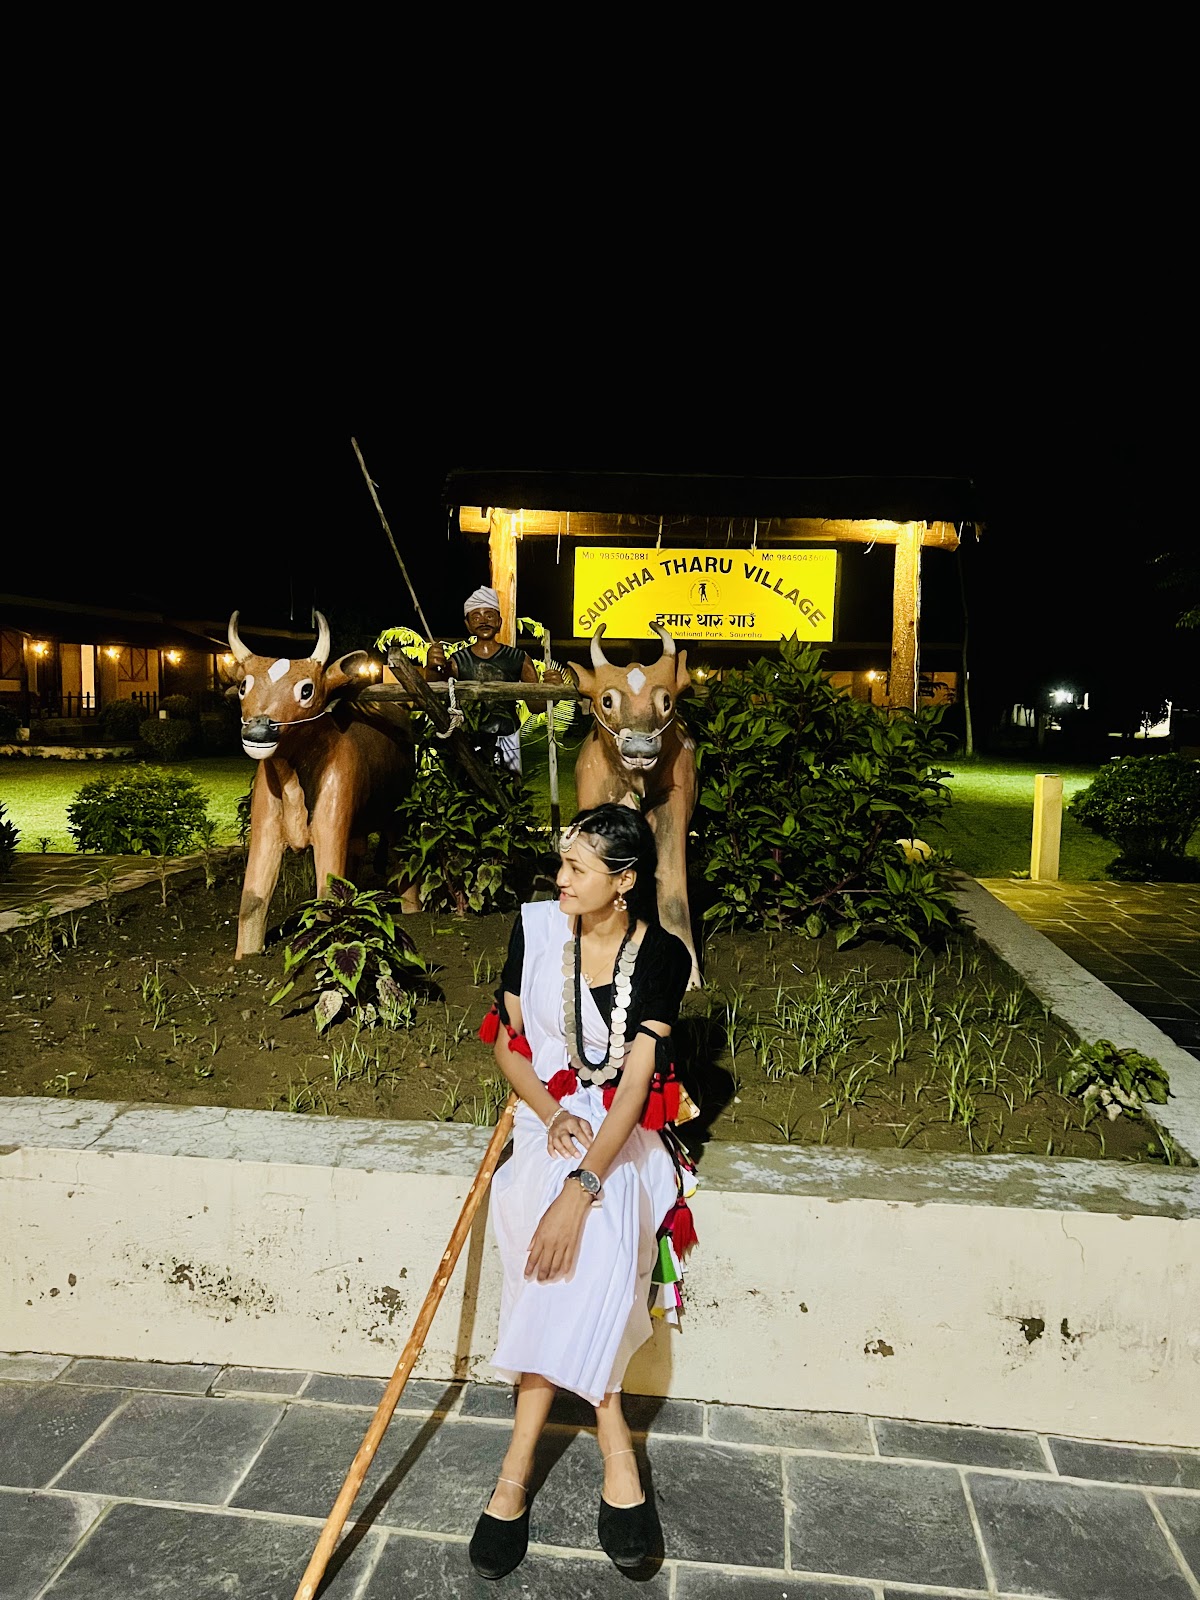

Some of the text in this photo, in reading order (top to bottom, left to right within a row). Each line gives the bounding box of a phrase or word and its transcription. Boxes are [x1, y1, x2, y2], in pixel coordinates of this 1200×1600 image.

[600, 552, 649, 561] 9855062881
[578, 556, 826, 630] SAURAHA THARU VILLAGE
[656, 614, 692, 628] हमार
